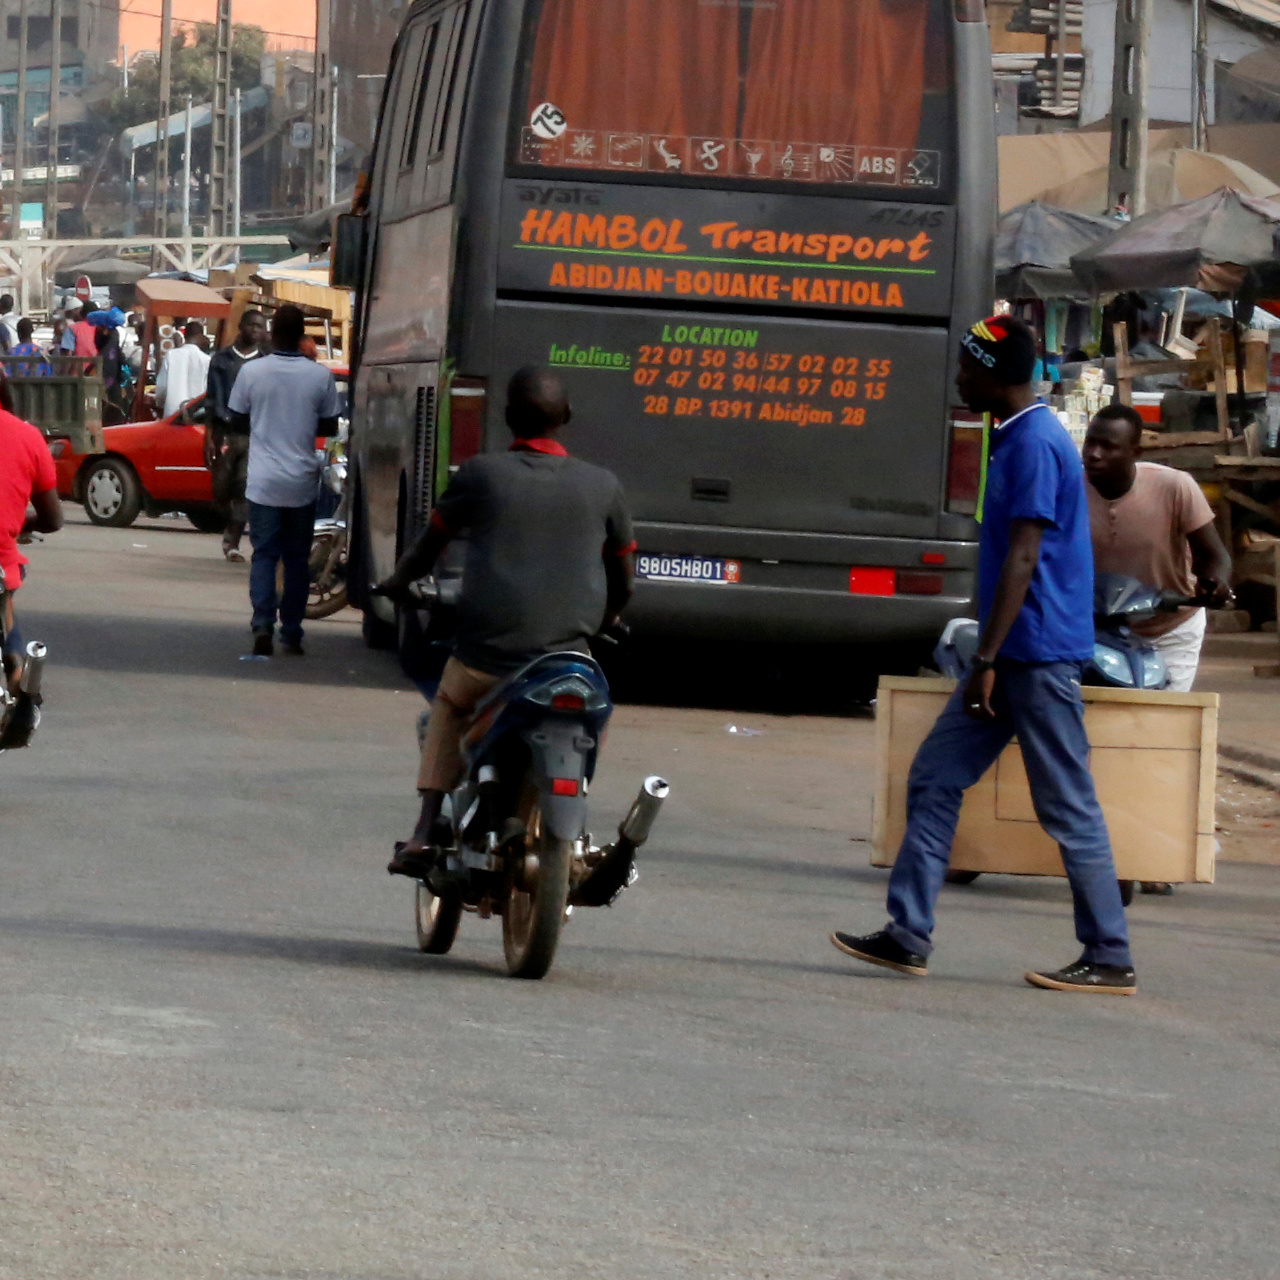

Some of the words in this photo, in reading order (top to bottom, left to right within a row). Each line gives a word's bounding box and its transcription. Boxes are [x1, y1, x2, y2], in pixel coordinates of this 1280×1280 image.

[532, 104, 565, 137] 75
[859, 156, 896, 175] ABS
[520, 208, 688, 254] HAMBOL
[700, 221, 932, 263] Transport
[549, 261, 904, 308] ABIDJAN-BOUAKE-KATIOLA
[661, 324, 759, 348] LOCATION
[548, 342, 632, 368] Infoline:
[638, 344, 665, 364] 22
[668, 347, 694, 366] 01
[699, 349, 727, 368] 50
[732, 350, 759, 369] 36
[766, 353, 793, 370] 57
[798, 354, 827, 374] 02
[832, 357, 860, 376] 02
[864, 358, 891, 378] 55
[633, 368, 660, 387] 07
[665, 370, 692, 388] 47
[698, 372, 726, 390] 02
[732, 374, 758, 393] 94
[762, 375, 791, 394] 44
[797, 378, 823, 396] 97
[830, 380, 857, 398] 08
[864, 382, 886, 401] 15
[643, 395, 670, 414] 28
[708, 399, 753, 419] 1391
[758, 402, 834, 427] Abidjan
[841, 406, 867, 427] 28
[639, 556, 722, 580] 9805HB01
